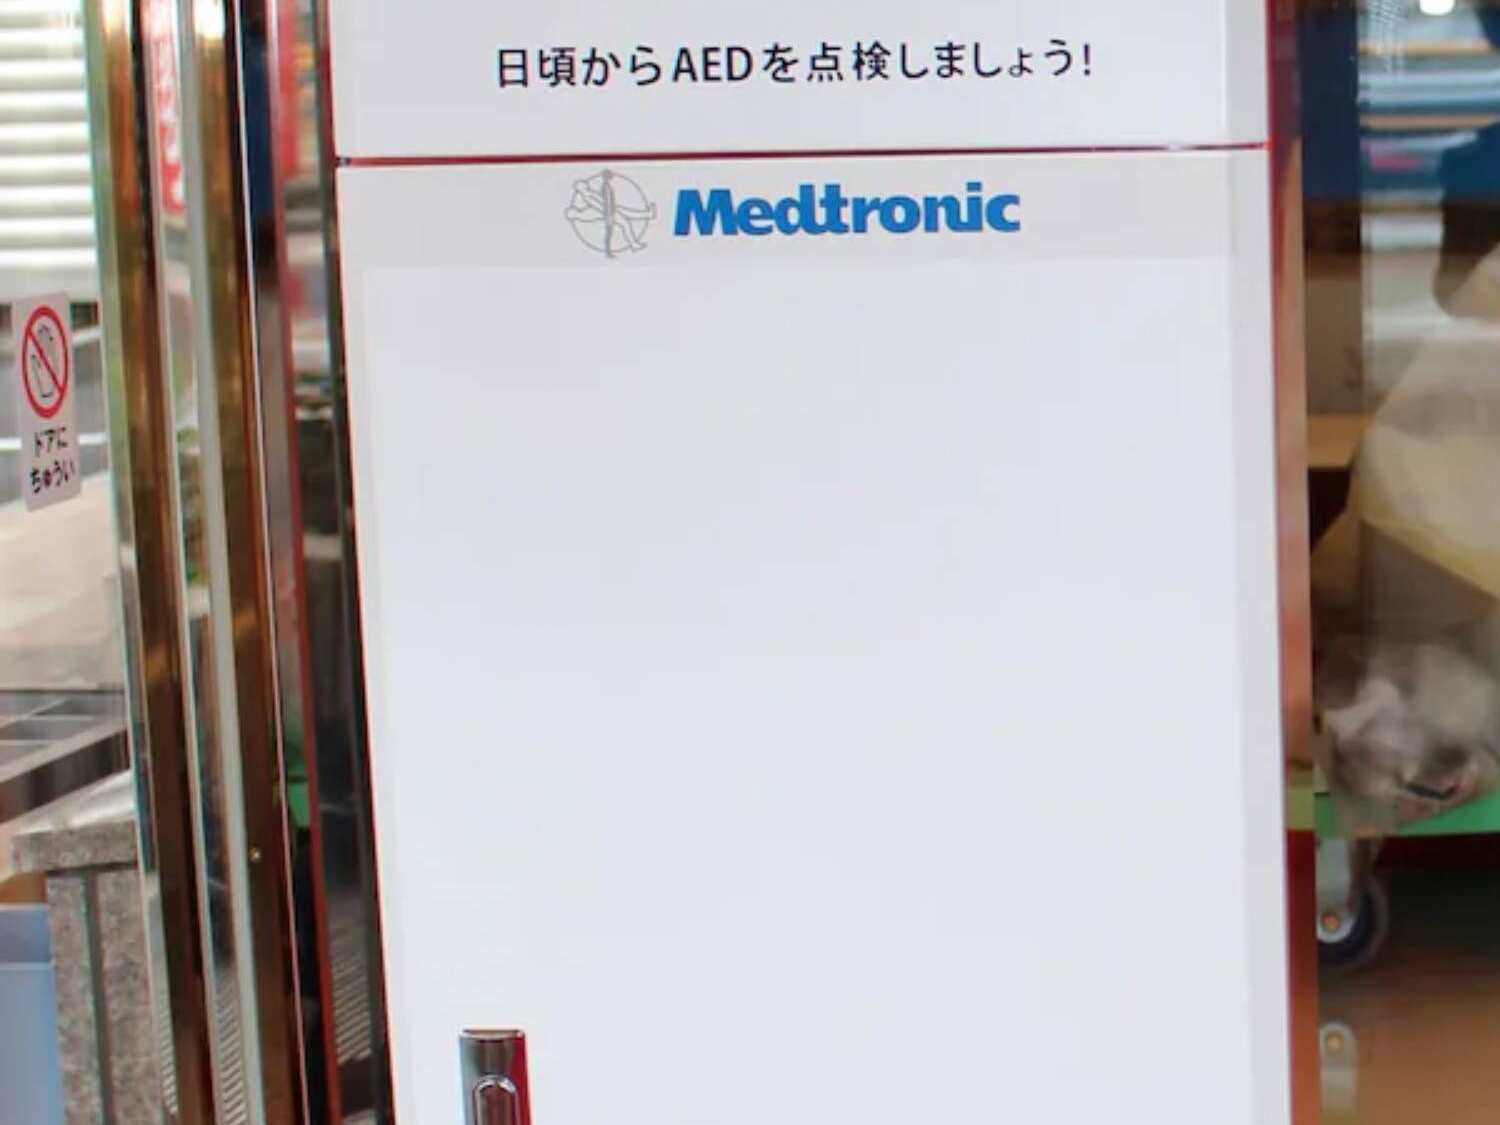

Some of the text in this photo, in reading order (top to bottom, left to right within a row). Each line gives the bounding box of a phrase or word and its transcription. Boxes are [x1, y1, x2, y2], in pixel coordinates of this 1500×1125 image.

[497, 39, 1093, 88] 日頃からAEDを点検しましょう!
[673, 181, 1022, 236] Medtronic
[33, 426, 68, 459] ドアに
[30, 460, 76, 494] ちゅうい
